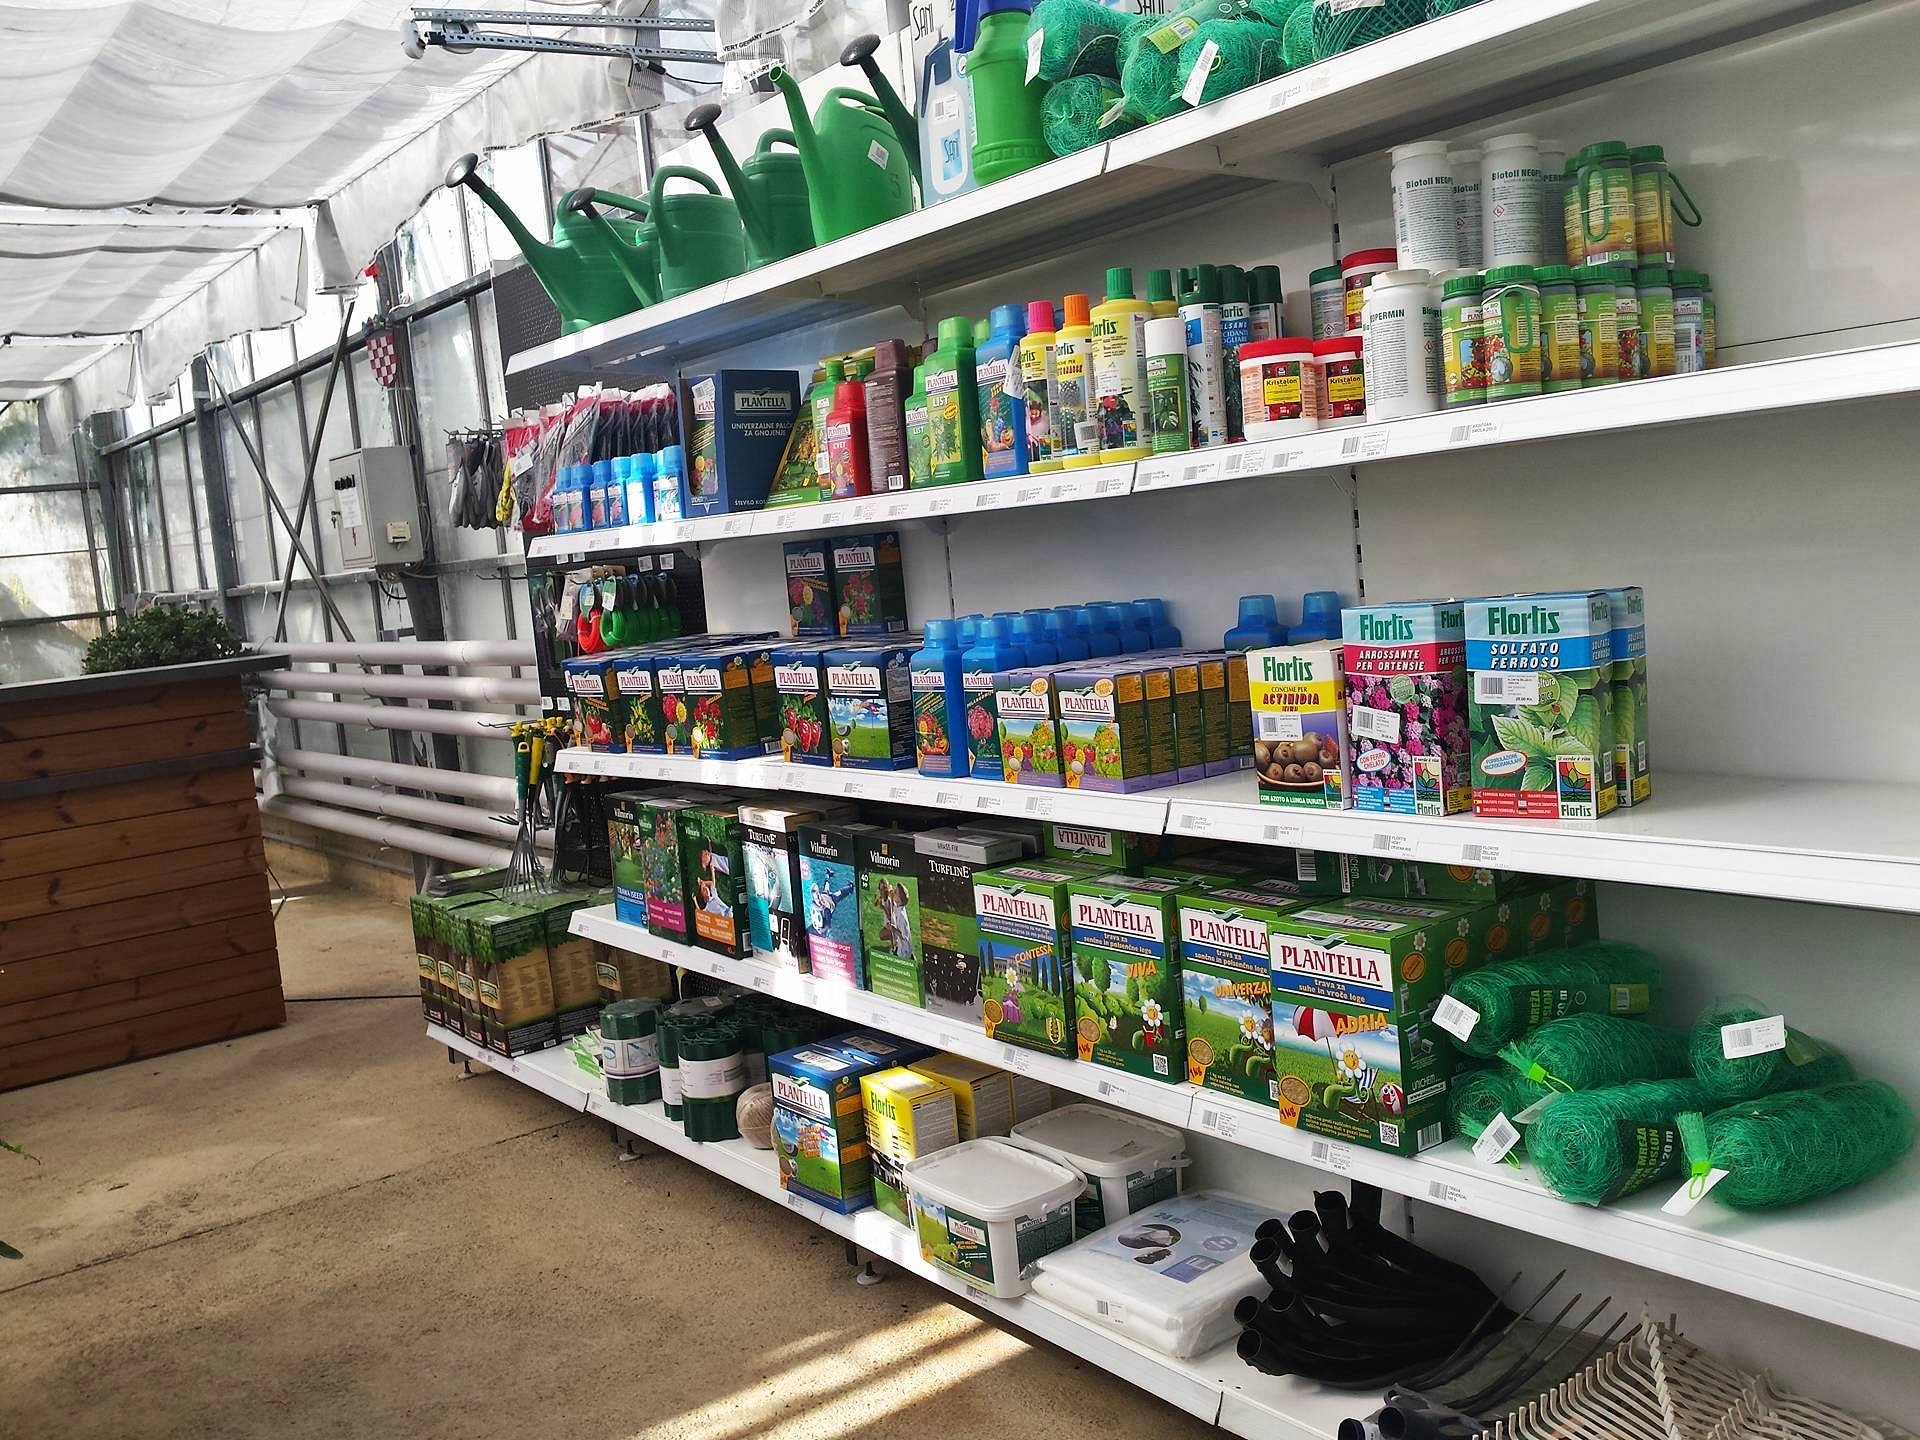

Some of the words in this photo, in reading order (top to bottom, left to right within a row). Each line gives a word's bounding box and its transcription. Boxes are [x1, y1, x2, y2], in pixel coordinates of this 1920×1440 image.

[1491, 170, 1520, 181] Biotoll
[1406, 177, 1433, 189] Biotoll
[927, 375, 955, 388] PLANTELLA
[1266, 379, 1297, 387] Kristalon
[1330, 376, 1360, 384] Kristalon
[741, 397, 786, 408] PLANTELLA
[933, 396, 948, 407] LIST
[731, 422, 774, 430] UNIVERZALNE
[790, 557, 821, 569] PLANTELLA
[838, 552, 871, 564] PLANTELLA
[1360, 613, 1413, 641] Flortis
[1488, 605, 1561, 636] Flortis
[1359, 650, 1420, 660] ARROSSANTE
[1490, 642, 1560, 655] SOLFATO
[1263, 655, 1314, 681] Flortis
[1356, 661, 1373, 671] PER
[1378, 661, 1425, 671] ORTENSIE
[1491, 656, 1560, 670] FERROSO
[574, 678, 600, 689] PLANTELLA
[620, 674, 648, 686] PLANTELLA
[687, 674, 717, 686] PLANTELLA
[779, 671, 814, 685] PLANTELLA
[832, 673, 875, 686] PLANTELLA
[913, 675, 942, 685] PLANTELLA
[1001, 697, 1045, 710] PLANTELLA
[1065, 698, 1109, 711] PLANTELLA
[1263, 693, 1320, 705] ACTINIDIA
[1370, 751, 1386, 761] FERRO
[1364, 760, 1384, 770] CHELATO
[614, 808, 634, 820] Vilmorin
[1417, 803, 1440, 816] Flortis
[1561, 804, 1592, 817] Flortis
[1058, 831, 1106, 848] PLANTELLA
[810, 841, 838, 857] Vilmorin
[870, 851, 900, 868] Vilmorin
[982, 894, 1048, 921] PLANTELLA
[1080, 904, 1154, 934] PLANTELLA
[1189, 918, 1268, 952] PLANTELLA
[1015, 944, 1052, 963] CONTESSA
[1216, 949, 1232, 958] trava
[1128, 960, 1157, 979] VIVA
[1281, 945, 1380, 981] PLANTELLA
[1315, 979, 1335, 989] trava
[1299, 985, 1316, 993] suhe
[1318, 987, 1325, 995] in
[1326, 989, 1348, 999] vroče
[1349, 993, 1365, 1003] lege
[1560, 990, 1568, 1001] m
[1335, 1012, 1388, 1035] ADRIA
[778, 1081, 825, 1111] PLANTELLA
[870, 1090, 896, 1121] Flortis
[1281, 1107, 1296, 1119] 1kg
[1666, 1131, 1674, 1143] m
[1637, 1127, 1648, 1167] MREŽA
[1663, 1144, 1672, 1160] 20
